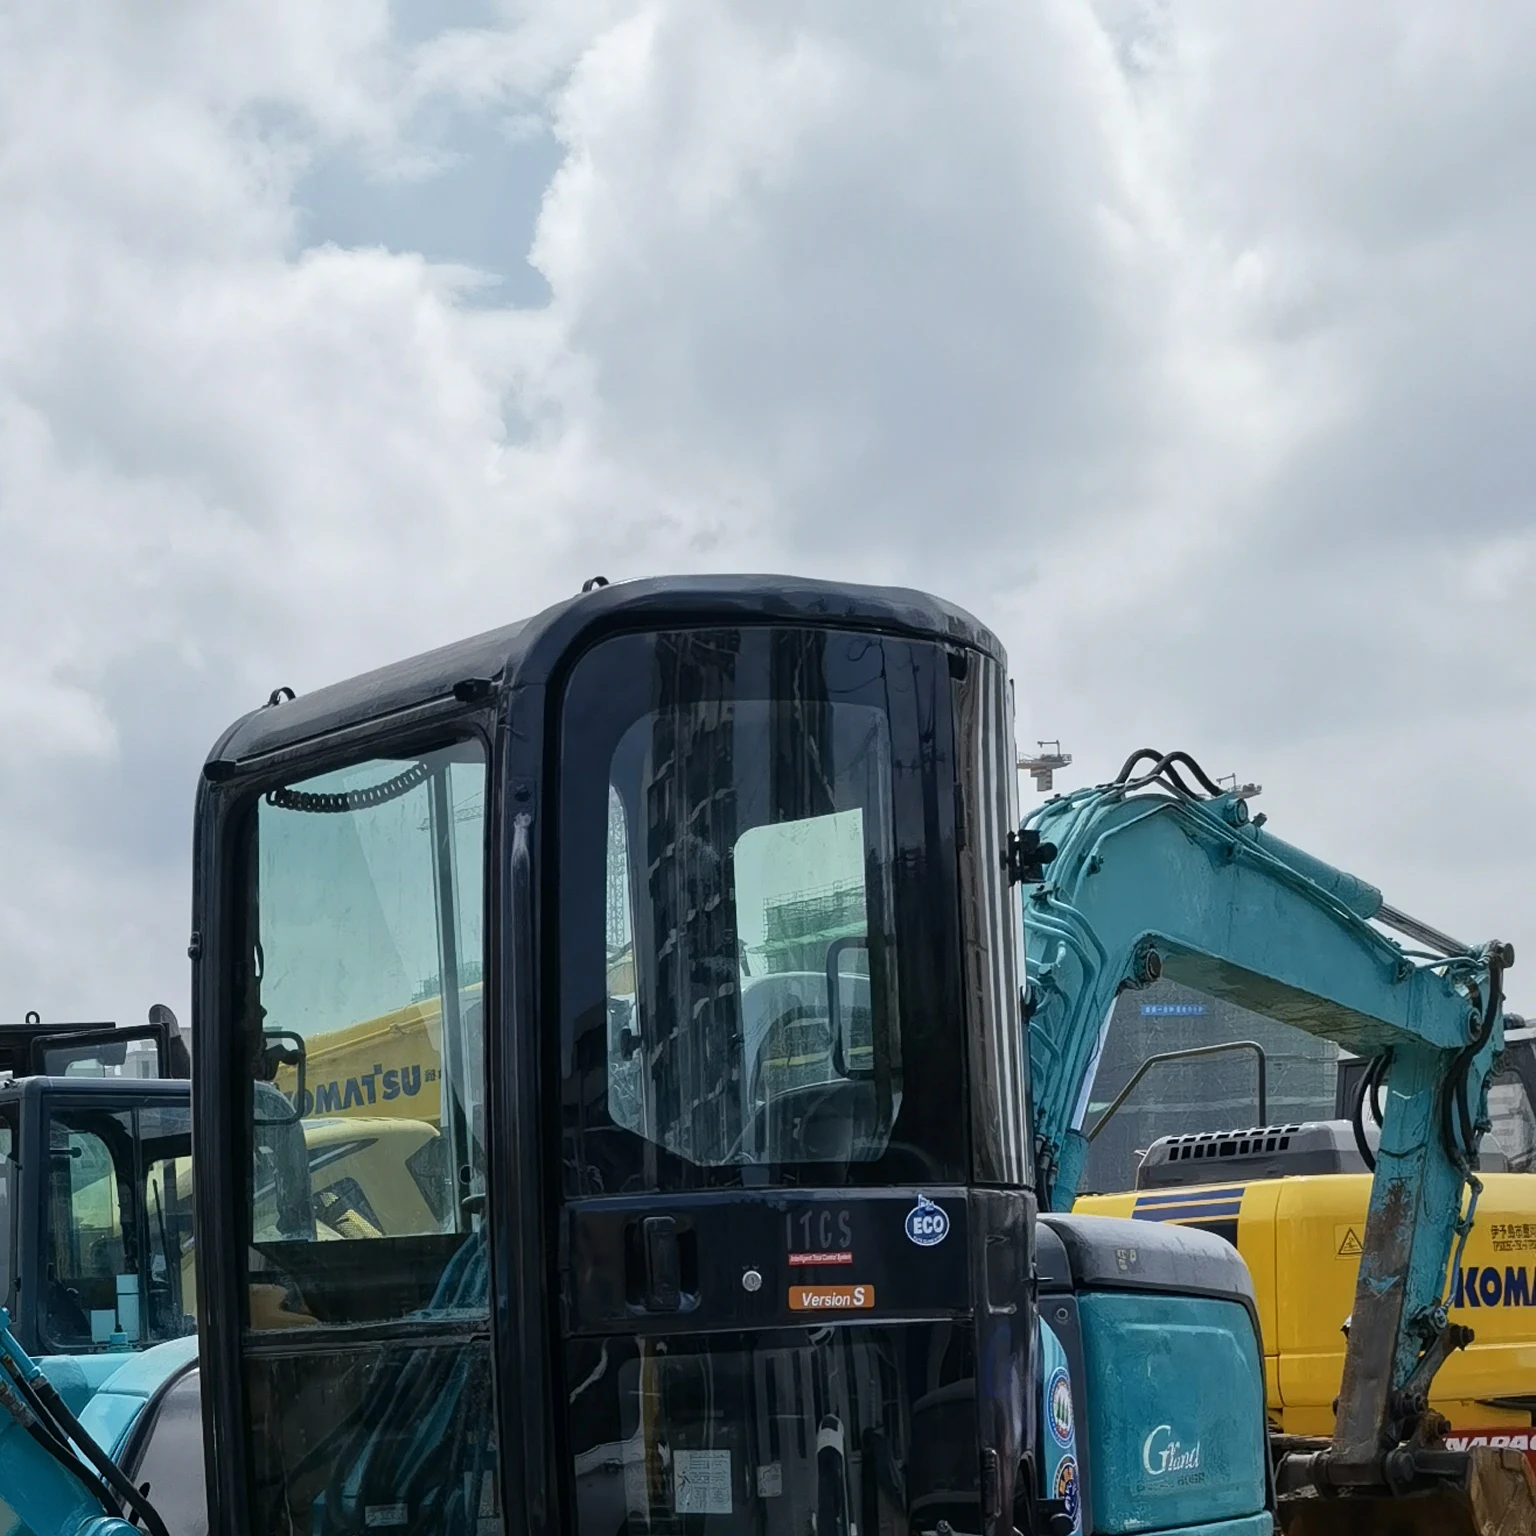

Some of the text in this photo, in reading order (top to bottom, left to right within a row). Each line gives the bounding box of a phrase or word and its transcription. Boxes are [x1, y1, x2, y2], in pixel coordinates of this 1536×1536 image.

[283, 1064, 421, 1119] OMATSU
[913, 1215, 944, 1235] ECO
[802, 1287, 865, 1307] Version S
[1454, 1266, 1536, 1308] KOM
